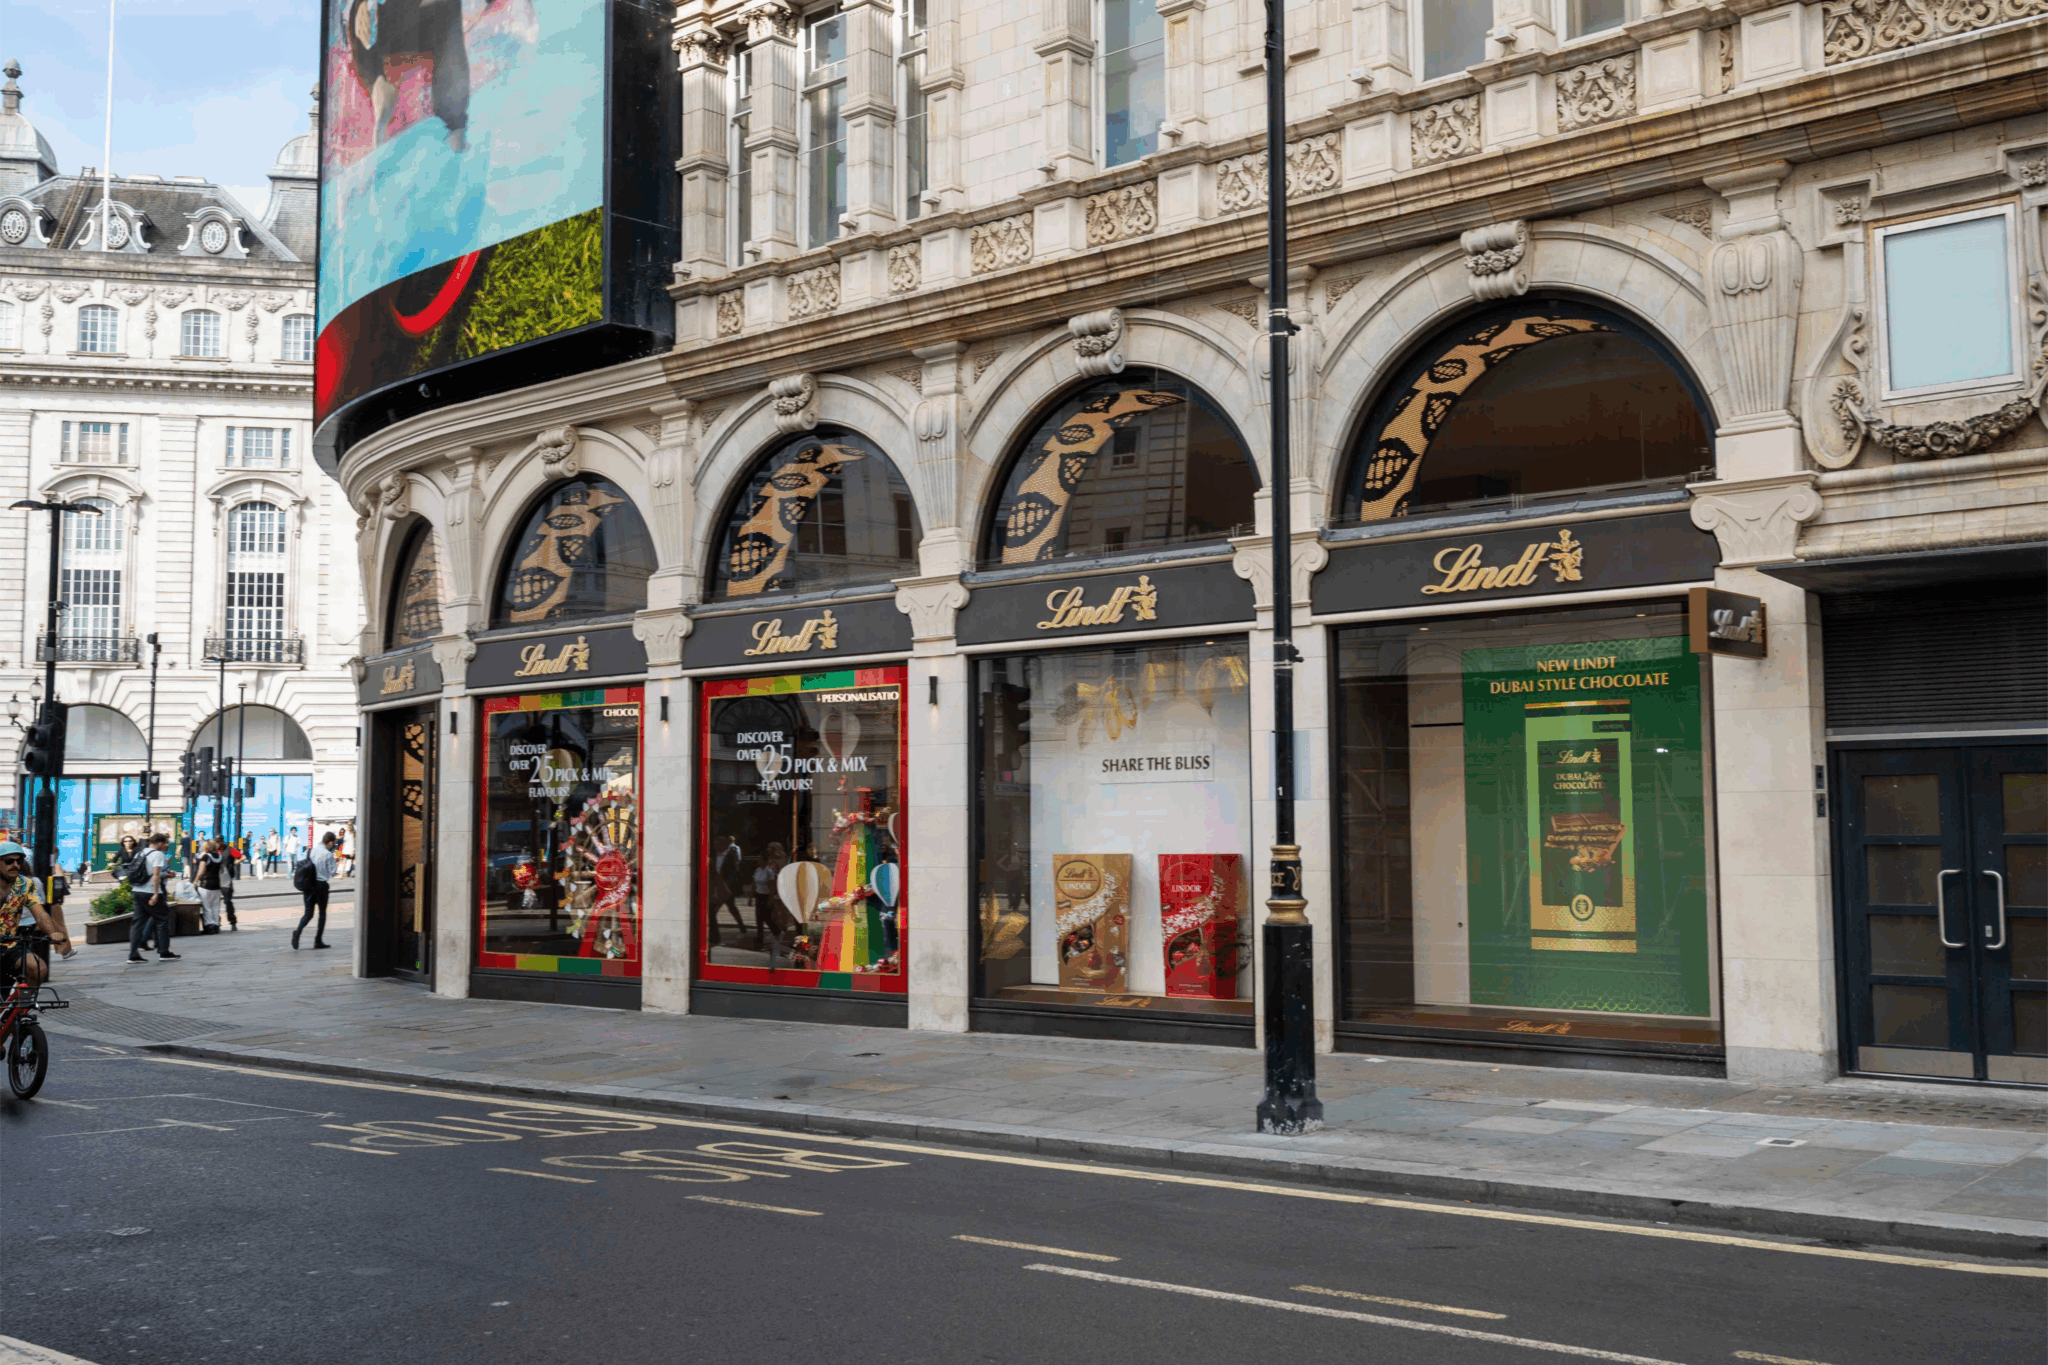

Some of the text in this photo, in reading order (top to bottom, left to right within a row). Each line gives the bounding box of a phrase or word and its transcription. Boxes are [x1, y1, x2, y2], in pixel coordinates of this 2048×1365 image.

[1421, 543, 1551, 594] Lindt
[1036, 586, 1133, 629] Lindt
[743, 618, 819, 656] Lindt
[514, 644, 574, 676] Lindt
[1537, 656, 1617, 673] NEW LINDT
[1490, 672, 1670, 694] DUBAI STYLE CHOCOLATE
[737, 731, 784, 744] DISCOVER
[509, 744, 548, 755] DISCOVER
[736, 744, 868, 775] OVER 25 PICK & MIX
[1556, 750, 1592, 764] Lindt
[509, 760, 530, 771] OVER
[529, 755, 554, 783] 25
[555, 768, 580, 782] PICK
[581, 767, 590, 782] &
[1102, 755, 1210, 773] SHARE THE BLISS
[761, 778, 813, 791] FLAVOURS!
[1555, 773, 1581, 781] DUBAI
